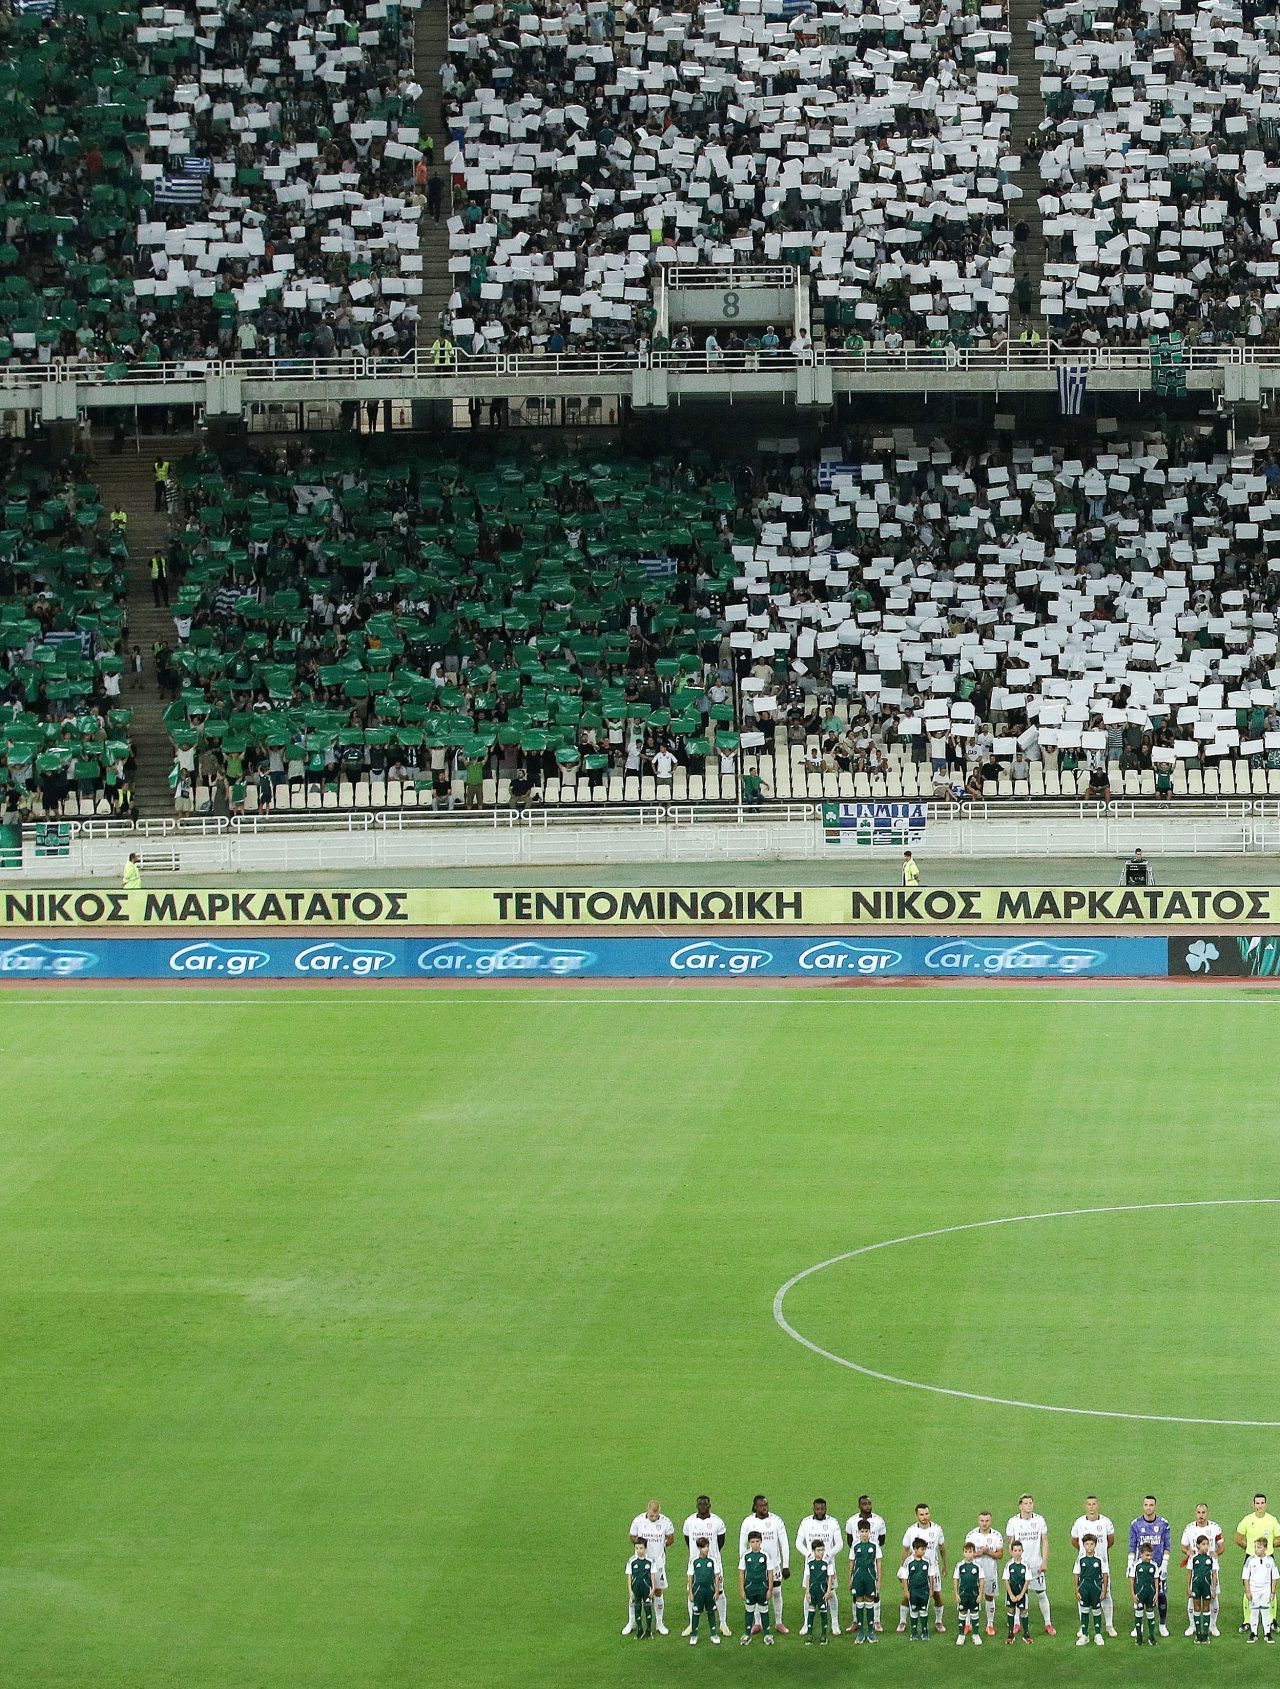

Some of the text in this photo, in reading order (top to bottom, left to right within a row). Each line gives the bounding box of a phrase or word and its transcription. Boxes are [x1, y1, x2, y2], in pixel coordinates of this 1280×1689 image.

[723, 291, 740, 318] 8
[843, 804, 923, 818] LAMIA
[5, 892, 408, 921] ΝΙΚΟΣ ΜΑΡΚΑΤΑΤΟΣ
[493, 890, 1269, 919] ΤΕΝΤΟΜΙΝΩΙΚΗ ΝΙΚΟΣ ΜΑΡΚΑΤΑΤΟΣ
